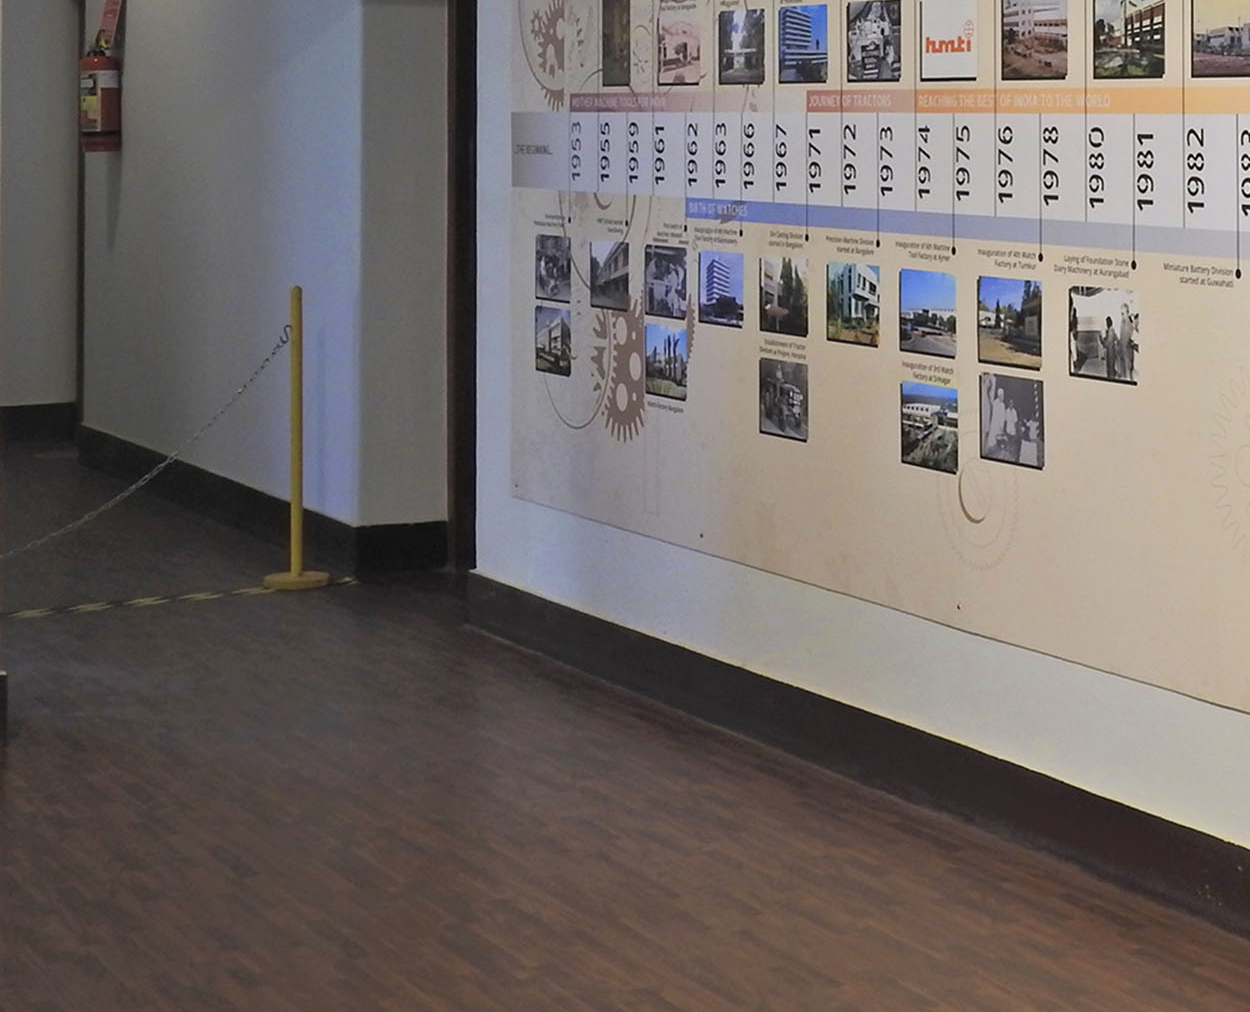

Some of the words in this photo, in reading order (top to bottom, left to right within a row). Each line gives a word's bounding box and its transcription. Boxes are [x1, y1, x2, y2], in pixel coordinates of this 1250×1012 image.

[919, 94, 957, 107] REACHING
[959, 94, 975, 107] THE
[1001, 94, 1013, 107] OF
[1015, 94, 1038, 107] INDIA
[1041, 94, 1053, 107] TO
[1056, 94, 1073, 107] THE
[1076, 94, 1111, 108] WORLD
[571, 121, 581, 181] 1953
[600, 122, 611, 183] 1955
[628, 122, 639, 184] 1959
[654, 125, 665, 185] 1961
[687, 123, 698, 187] 1962
[715, 122, 727, 188] 1963
[743, 123, 755, 189] 1966
[775, 124, 788, 191] 1967
[809, 128, 821, 193] 1971
[844, 124, 856, 195] 1972
[880, 126, 893, 197] 1973
[918, 125, 931, 198] 1974
[956, 125, 970, 201] 1975
[998, 126, 1013, 203] 1976
[1043, 126, 1059, 206] 1978
[1089, 127, 1104, 208] 1980
[1137, 133, 1154, 211] 1981
[1187, 128, 1204, 214] 1982
